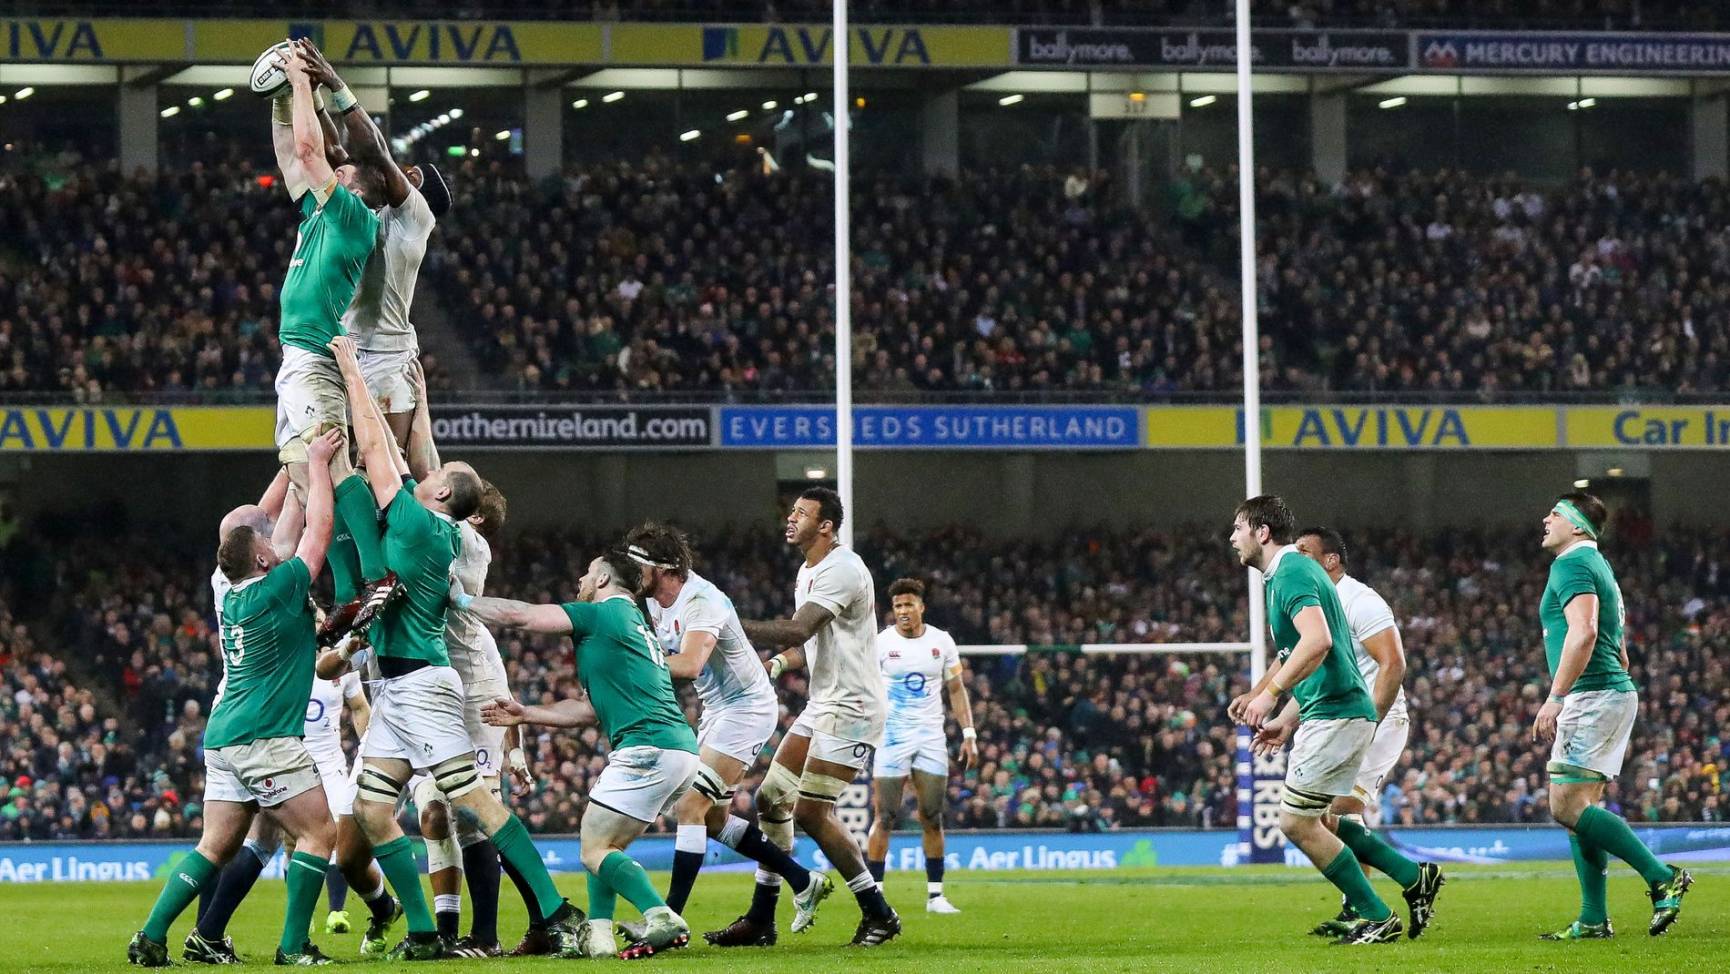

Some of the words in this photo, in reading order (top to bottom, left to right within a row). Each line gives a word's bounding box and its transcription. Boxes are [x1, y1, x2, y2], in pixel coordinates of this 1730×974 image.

[346, 23, 522, 62] AVIVA
[758, 27, 931, 64] AVVA
[1465, 43, 1579, 64] MERCURY
[0, 409, 182, 448] AVIVA
[730, 416, 922, 440] EVERSEDS
[934, 415, 1126, 440] SUTHERLAND
[1293, 409, 1470, 447] AVIVA
[1614, 411, 1689, 445] Car
[0, 857, 48, 883] Aer
[52, 856, 150, 882] Lingus
[968, 846, 1020, 872] Aer
[1023, 845, 1117, 871] Lingus
